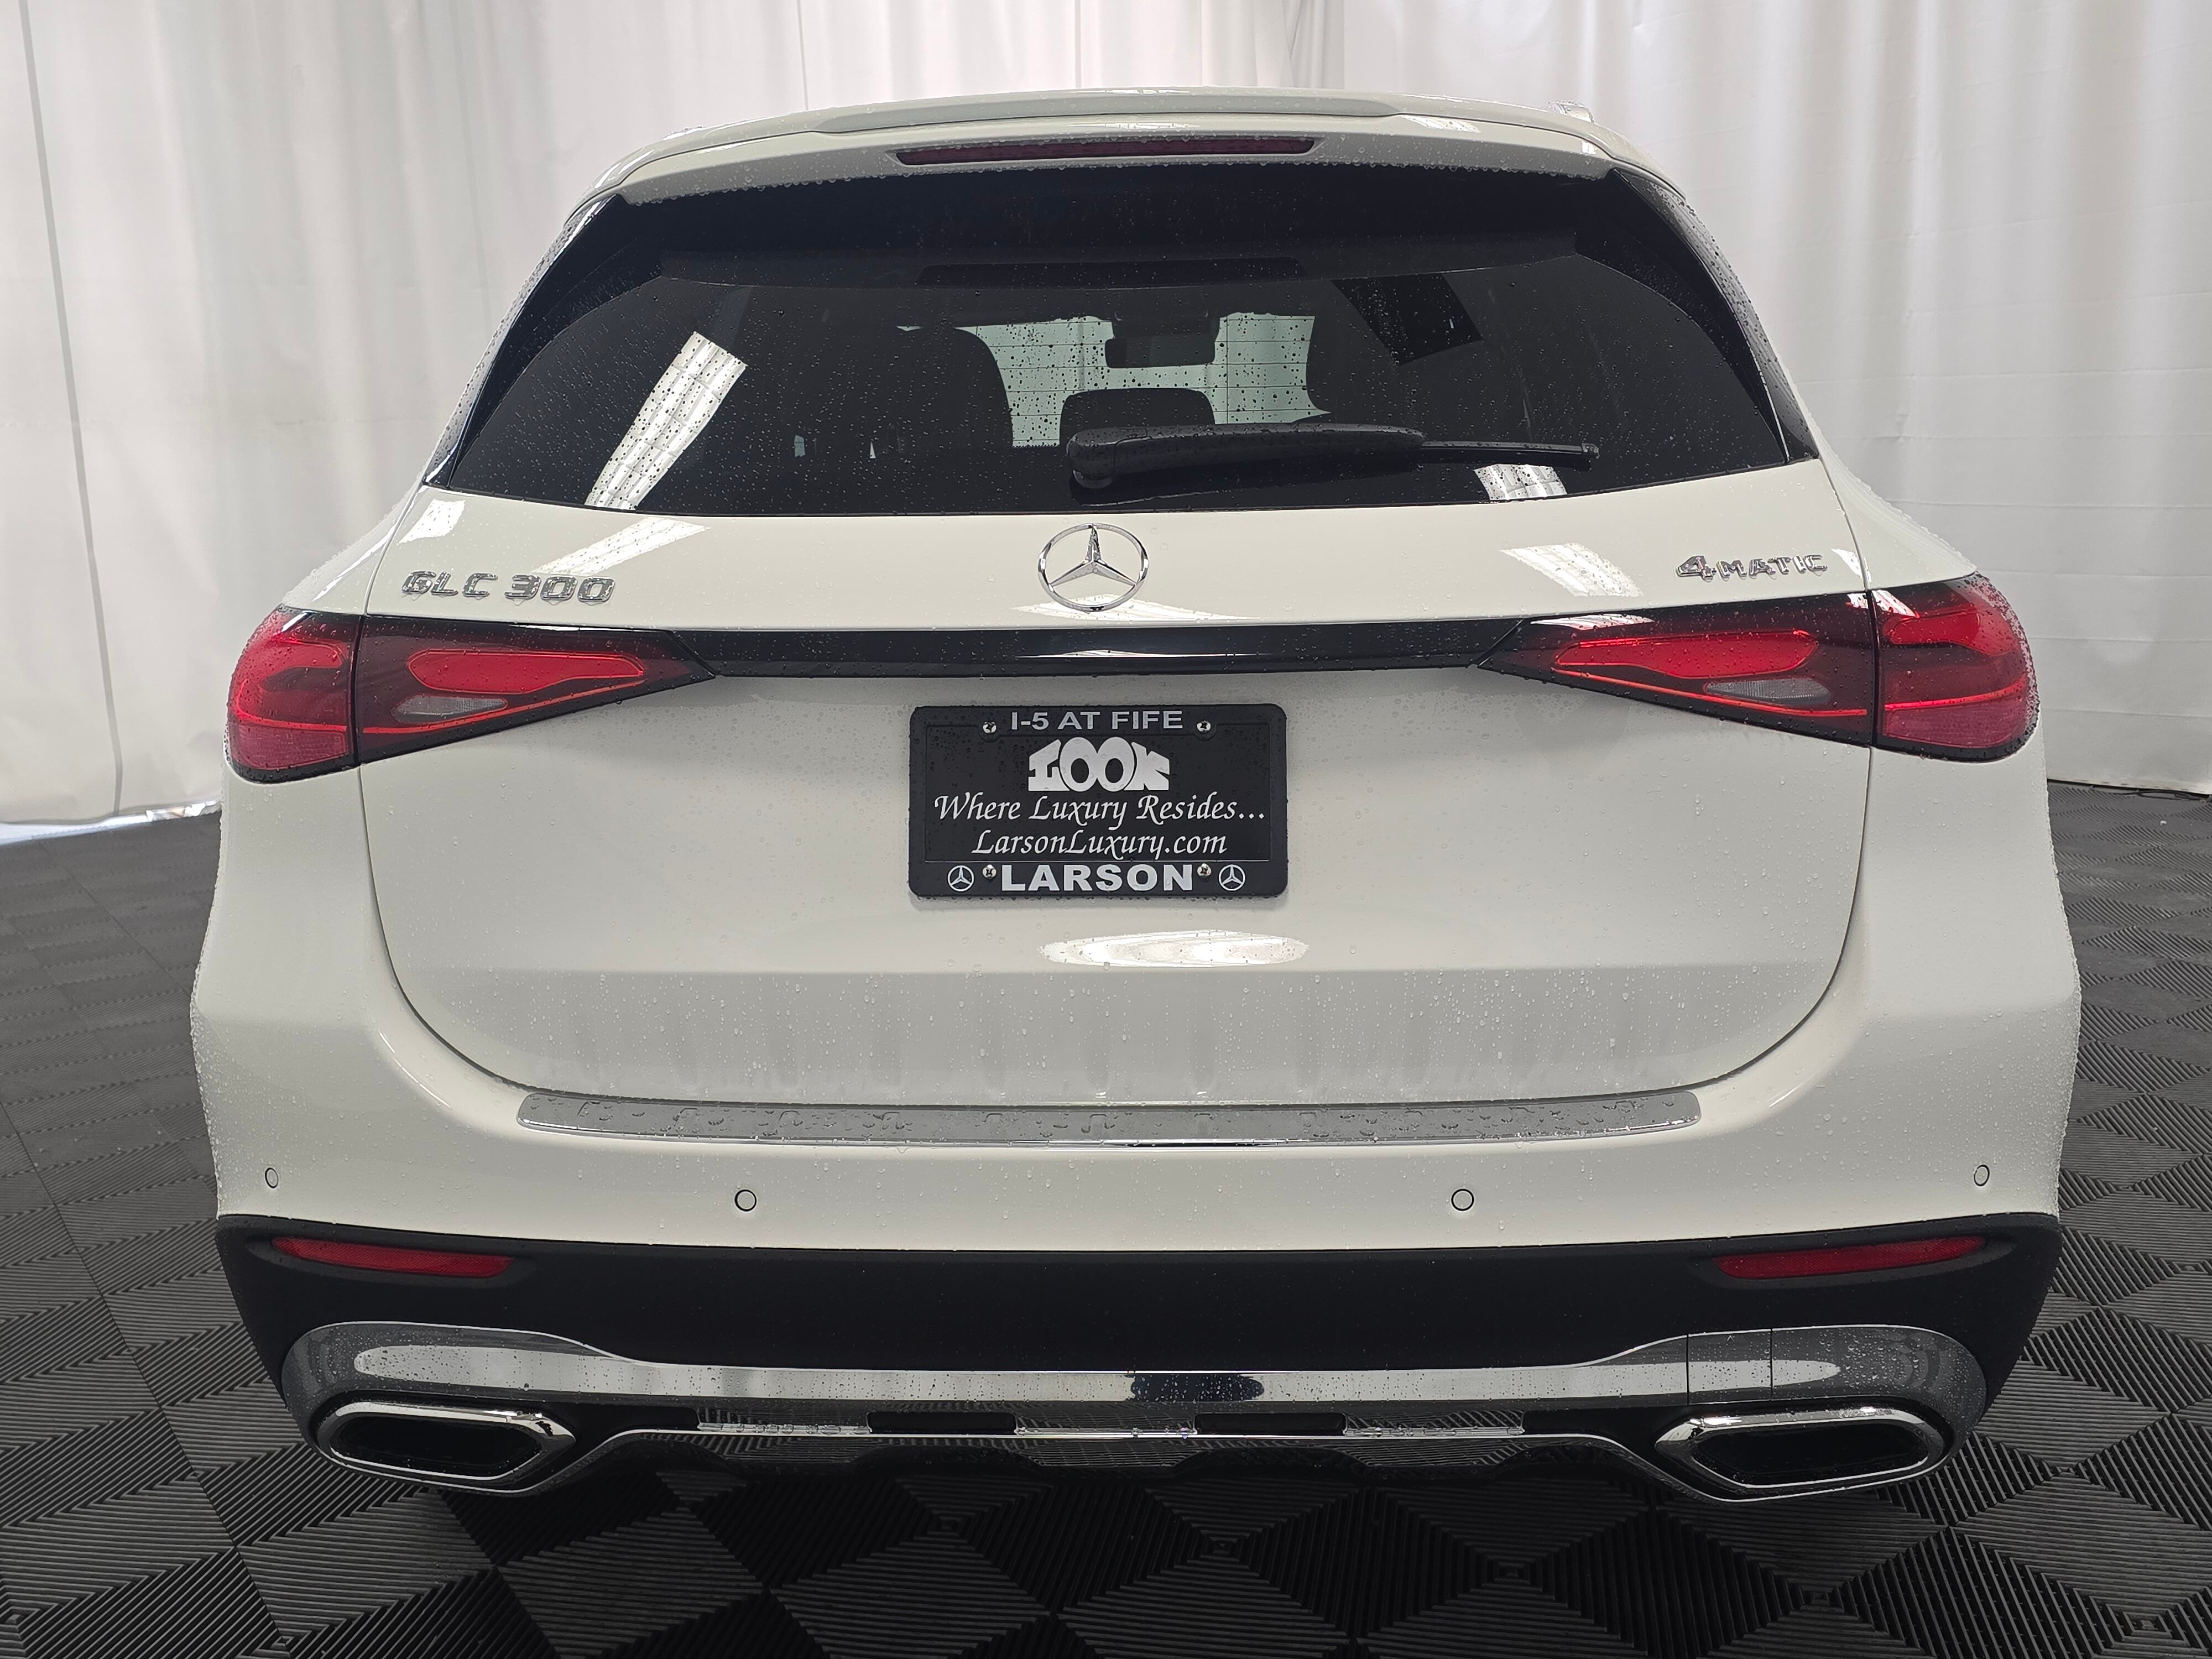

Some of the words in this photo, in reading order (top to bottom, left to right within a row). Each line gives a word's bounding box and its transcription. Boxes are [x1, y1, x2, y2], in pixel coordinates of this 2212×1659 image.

[1676, 554, 1828, 580] 4MATIC
[401, 570, 497, 597] GLC
[504, 575, 616, 603] 300
[1011, 712, 1049, 730] I-5
[1057, 711, 1100, 729] AT
[1112, 711, 1183, 729] FIFE
[935, 792, 1021, 820] Where
[1028, 796, 1128, 830] Luxury
[1136, 792, 1265, 825] Resides...
[971, 830, 1227, 860] LarsonLuxury.com
[1001, 864, 1192, 891] LARSON
